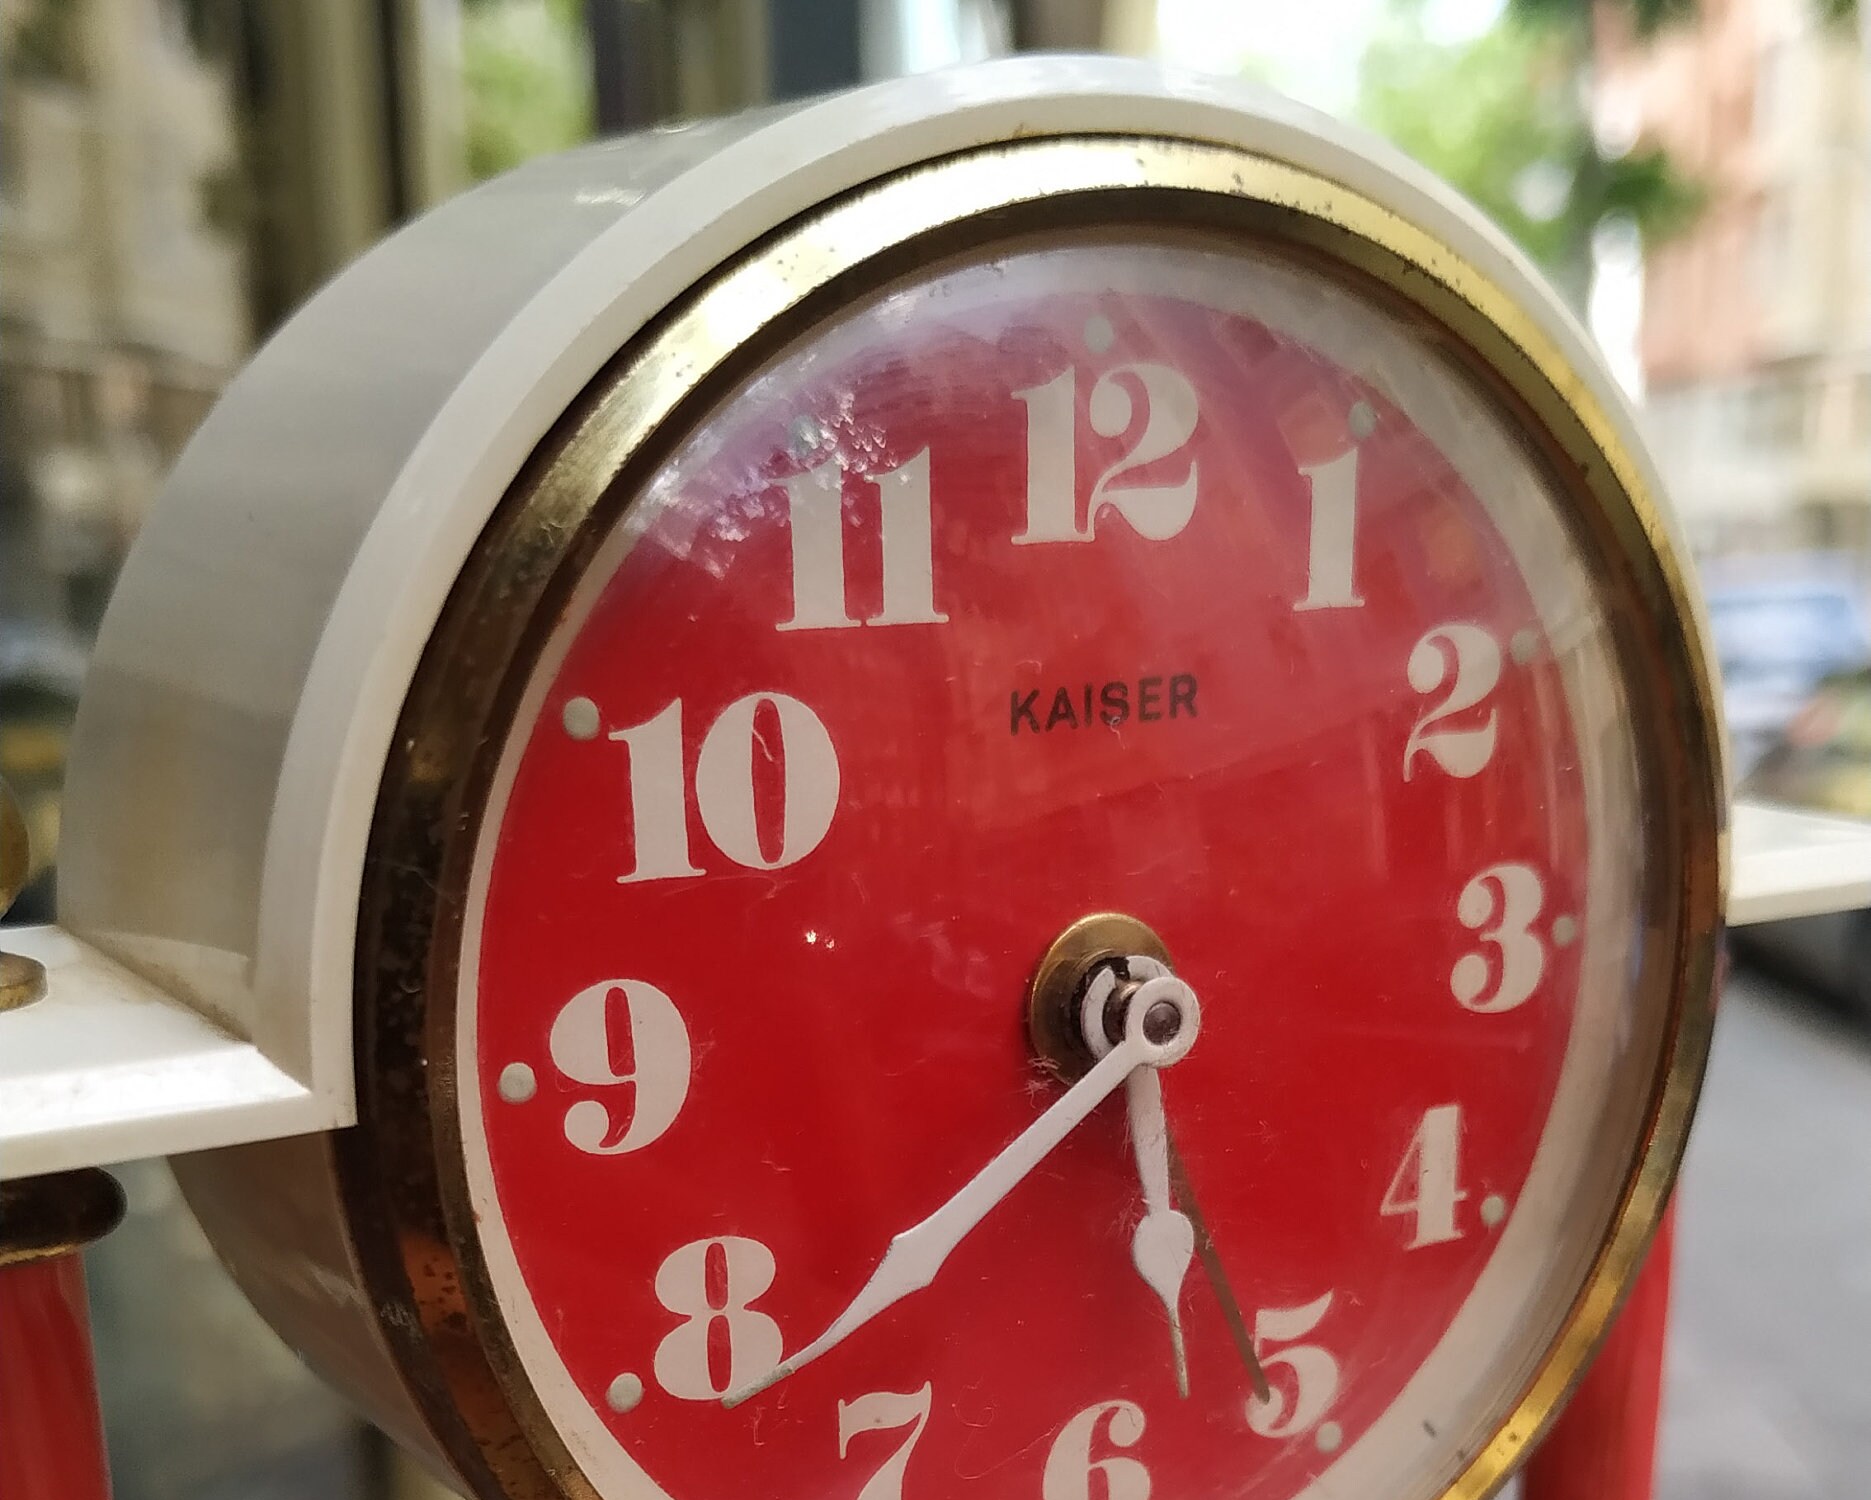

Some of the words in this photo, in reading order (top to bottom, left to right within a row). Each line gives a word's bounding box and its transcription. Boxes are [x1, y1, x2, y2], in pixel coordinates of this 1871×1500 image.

[1011, 363, 1199, 544] 12
[1293, 446, 1365, 612] 1
[775, 446, 949, 632] 11
[1010, 673, 1199, 737] KAISER
[1403, 623, 1501, 783] 2
[608, 691, 841, 885] 10
[1450, 863, 1546, 1015] 3
[549, 978, 692, 1156] 9
[1380, 1103, 1467, 1250] 4
[653, 1235, 784, 1402] 8
[1244, 1289, 1339, 1439] 5
